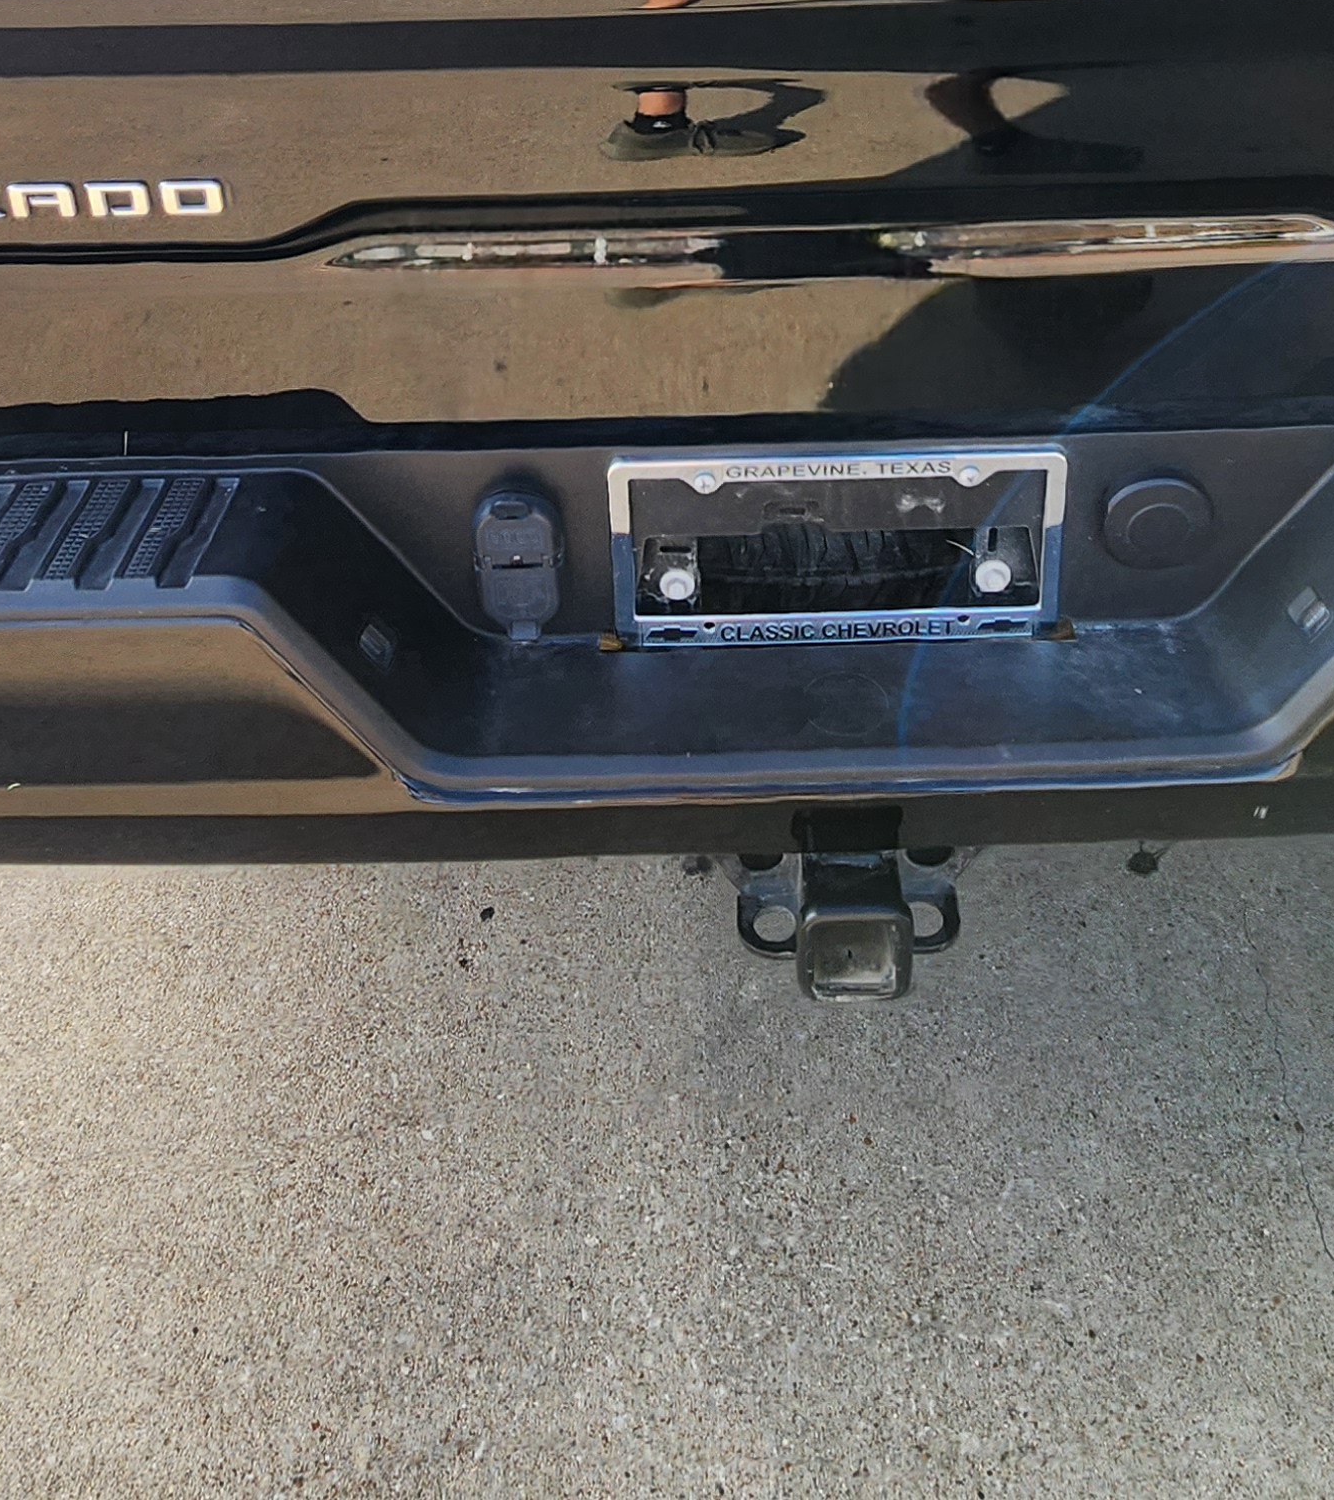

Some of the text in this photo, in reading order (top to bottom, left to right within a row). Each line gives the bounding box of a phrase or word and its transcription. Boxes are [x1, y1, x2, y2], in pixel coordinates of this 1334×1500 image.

[878, 461, 952, 475] TEXAS
[720, 619, 955, 642] CLASSIC CHEVROLET
